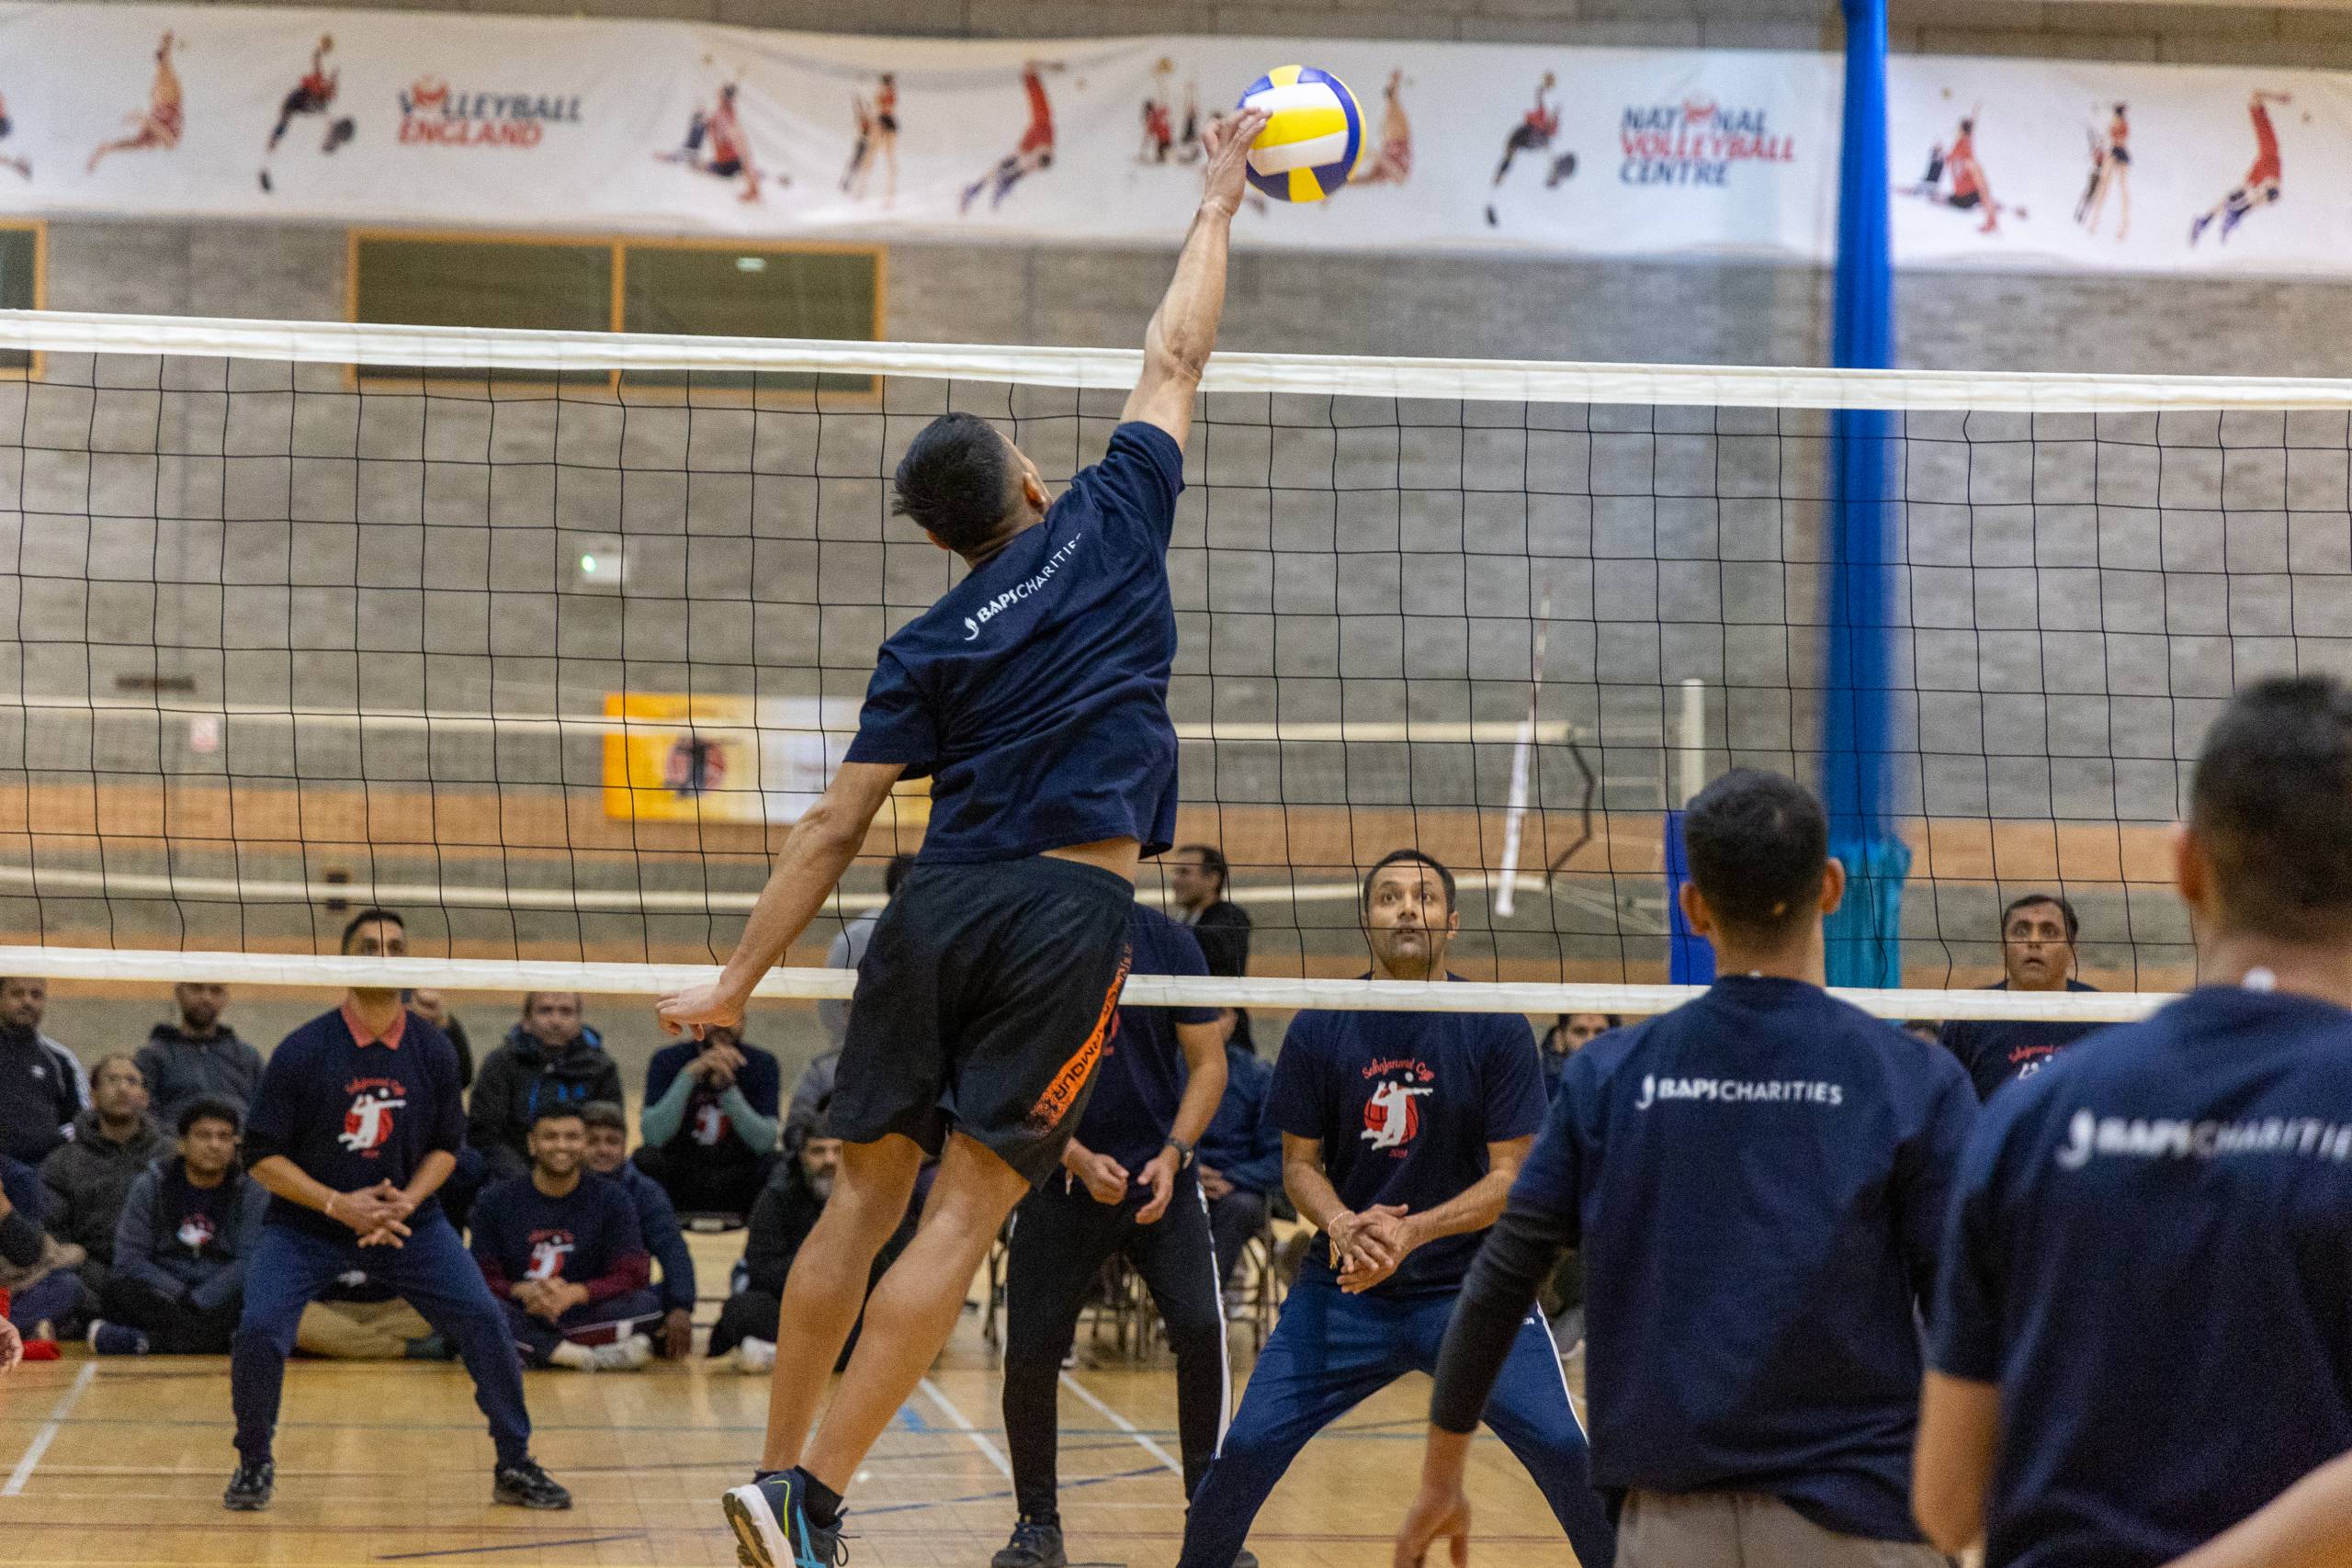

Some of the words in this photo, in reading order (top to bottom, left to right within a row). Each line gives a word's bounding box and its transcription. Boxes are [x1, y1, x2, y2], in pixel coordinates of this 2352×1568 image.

[399, 118, 543, 146] ENGLAND
[1621, 131, 1793, 162] VOLLEYBALL
[1620, 159, 1728, 186] CENTRE
